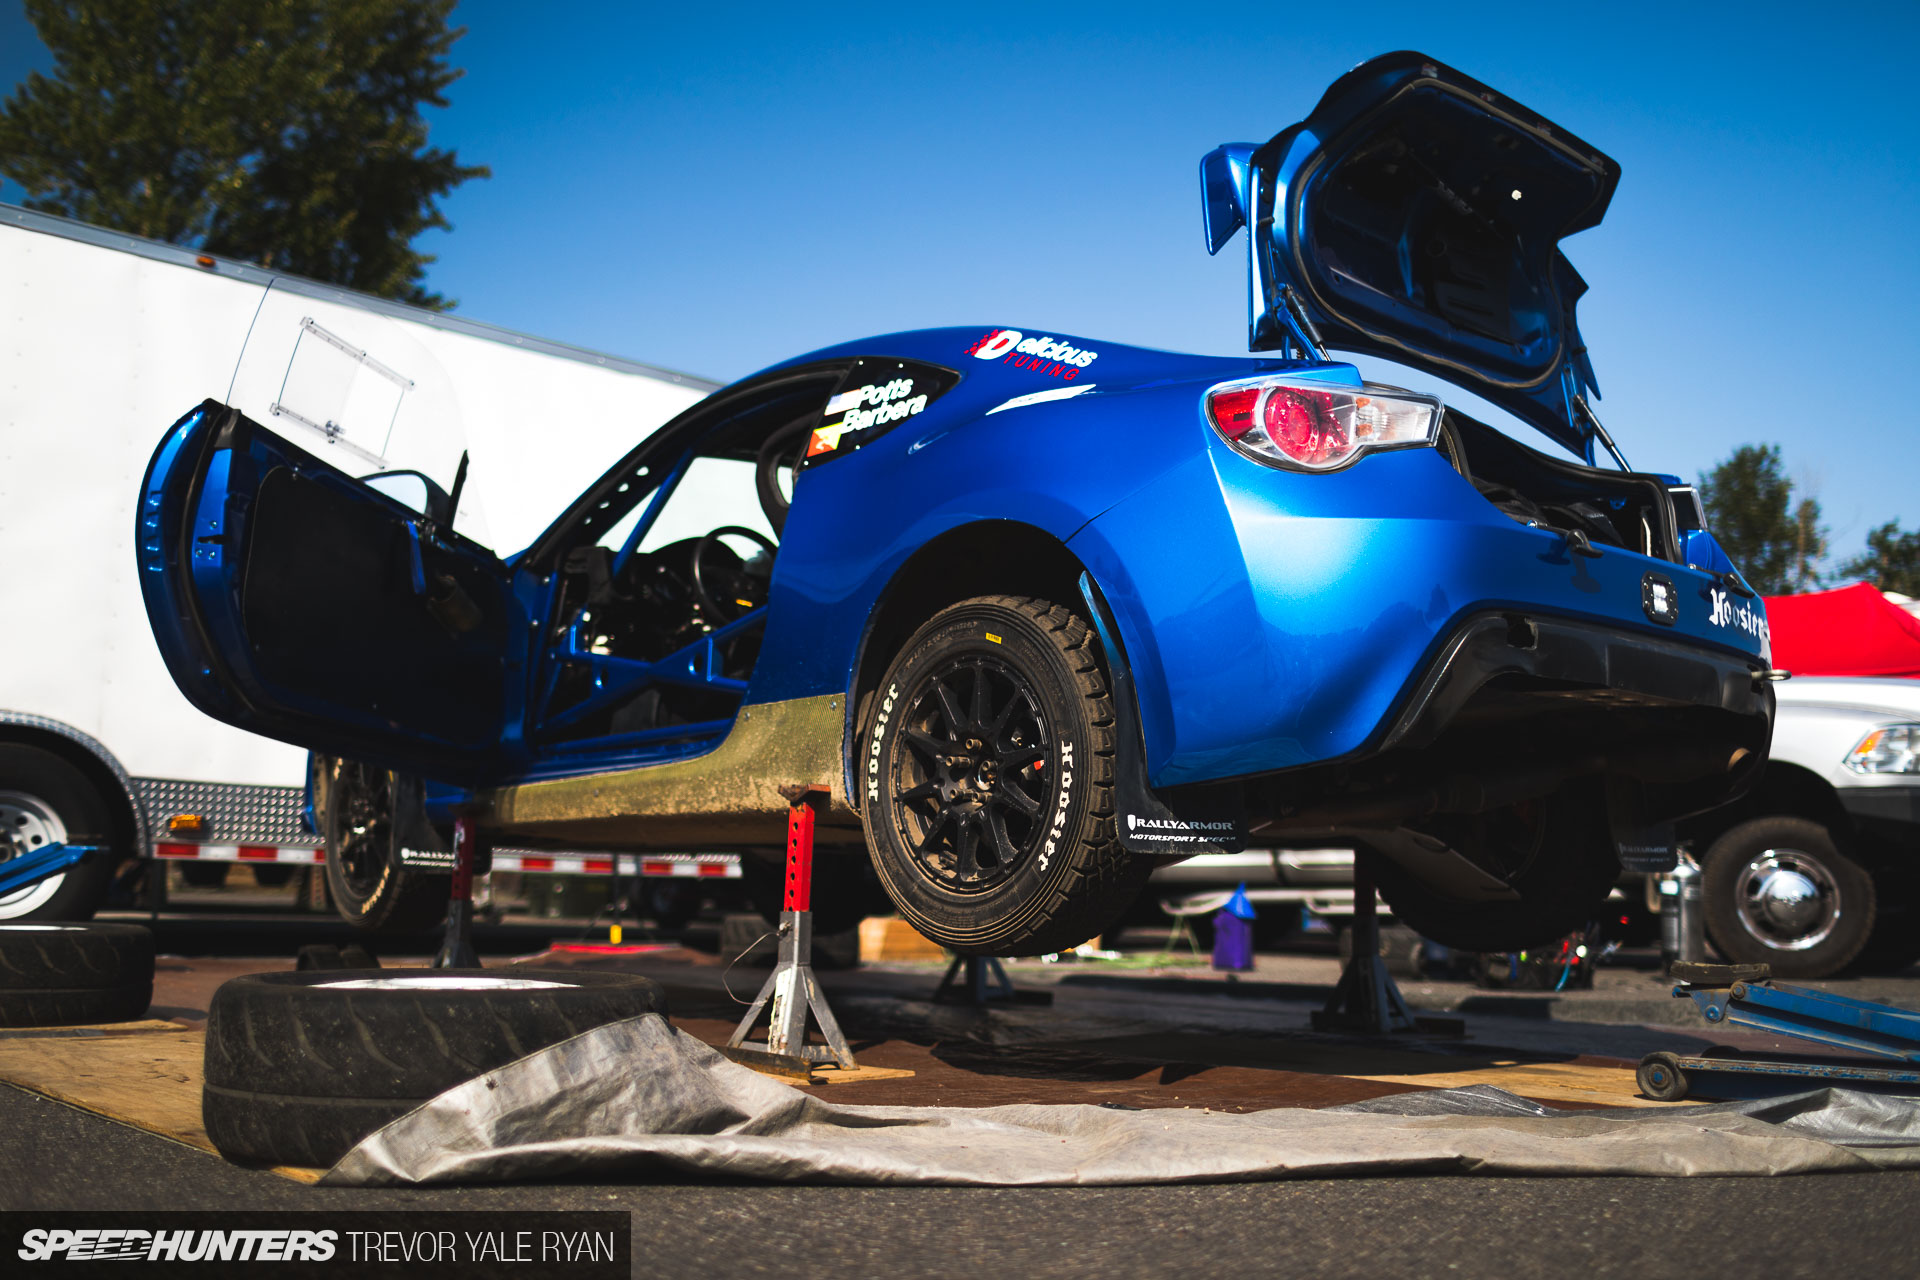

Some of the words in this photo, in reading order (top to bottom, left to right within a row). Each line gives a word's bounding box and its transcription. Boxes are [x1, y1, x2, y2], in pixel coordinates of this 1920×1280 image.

[974, 330, 1098, 368] Delicious
[1003, 351, 1080, 381] TUNING
[854, 378, 914, 408] Potts
[841, 394, 928, 434] Barbera
[1708, 588, 1764, 640] Hoosier
[867, 683, 899, 802] Hoosier
[1038, 740, 1074, 872] Hoosier
[1136, 818, 1233, 830] RALLYARMOR
[1129, 833, 1196, 842] MOTORSPORT
